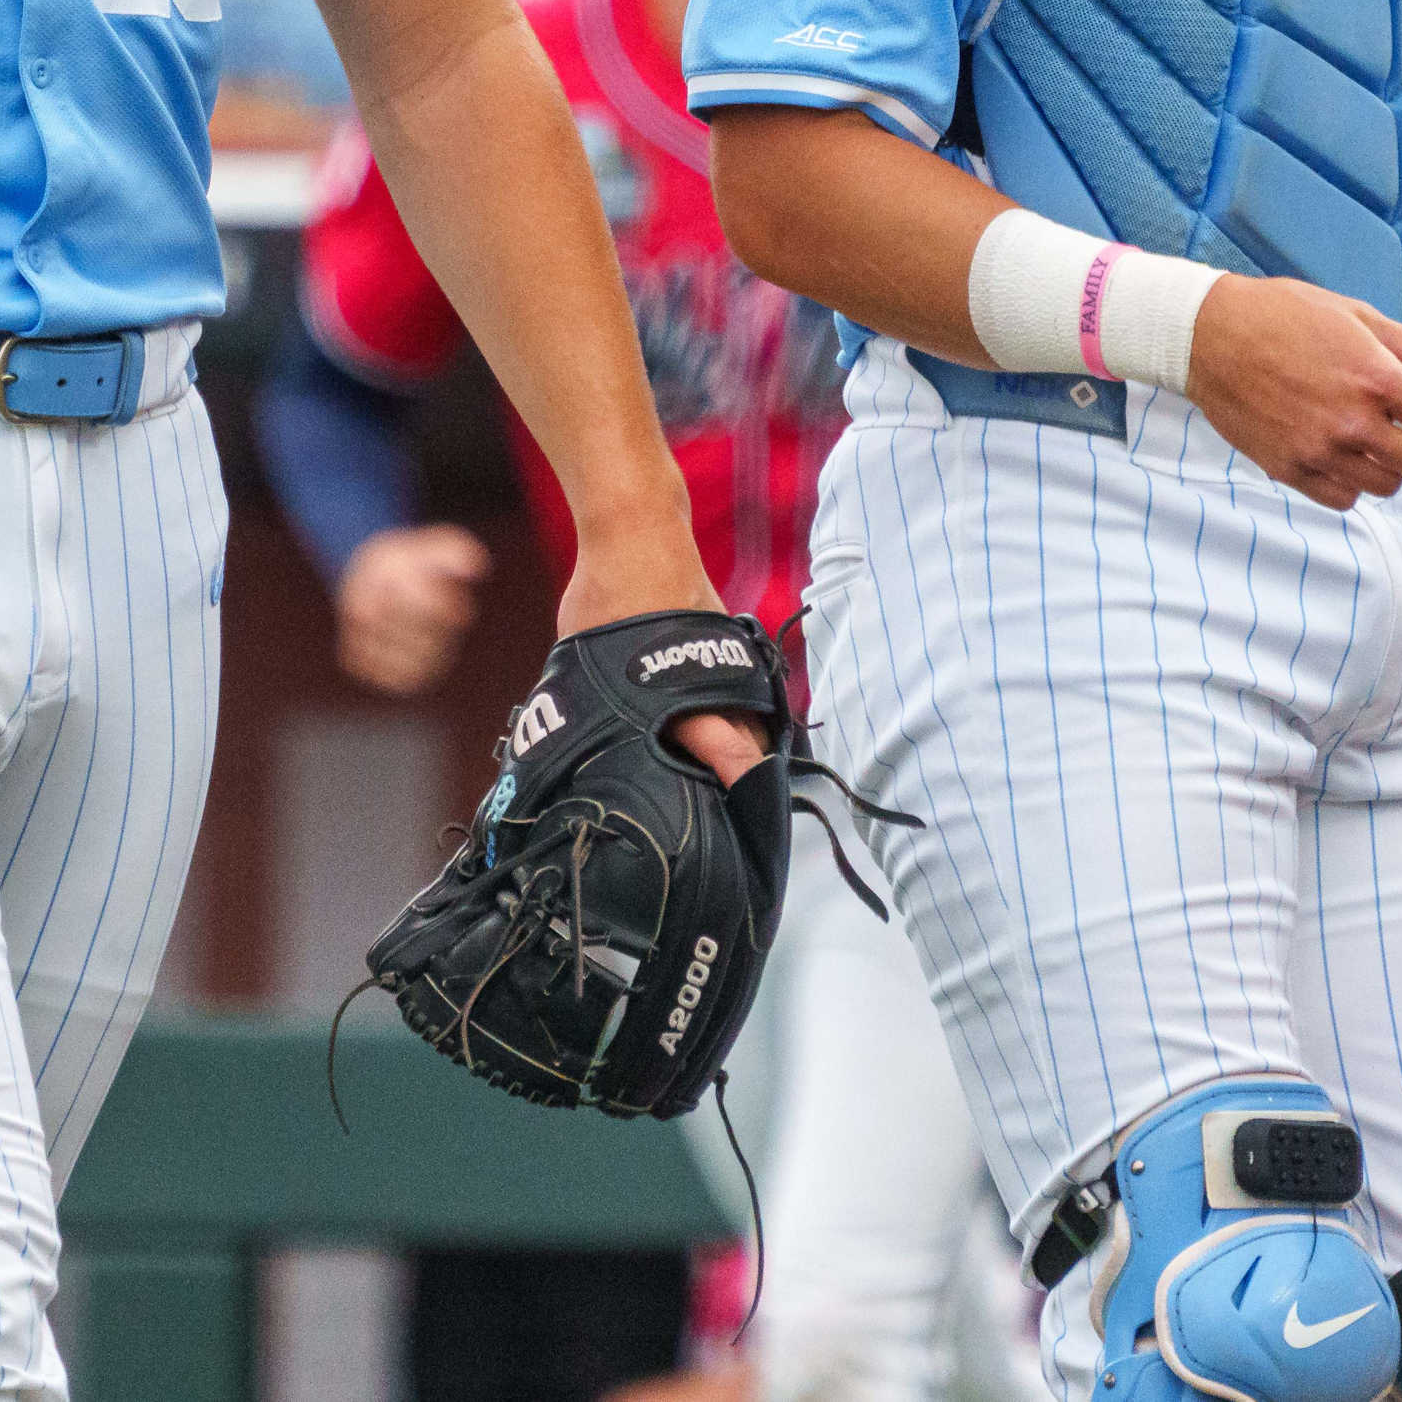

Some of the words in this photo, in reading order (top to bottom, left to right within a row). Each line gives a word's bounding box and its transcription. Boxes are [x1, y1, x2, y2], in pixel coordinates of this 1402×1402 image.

[773, 23, 866, 53] ACC
[1080, 256, 1109, 336] FAMILY
[640, 639, 754, 674] Wilson
[658, 935, 719, 1057] A2000
